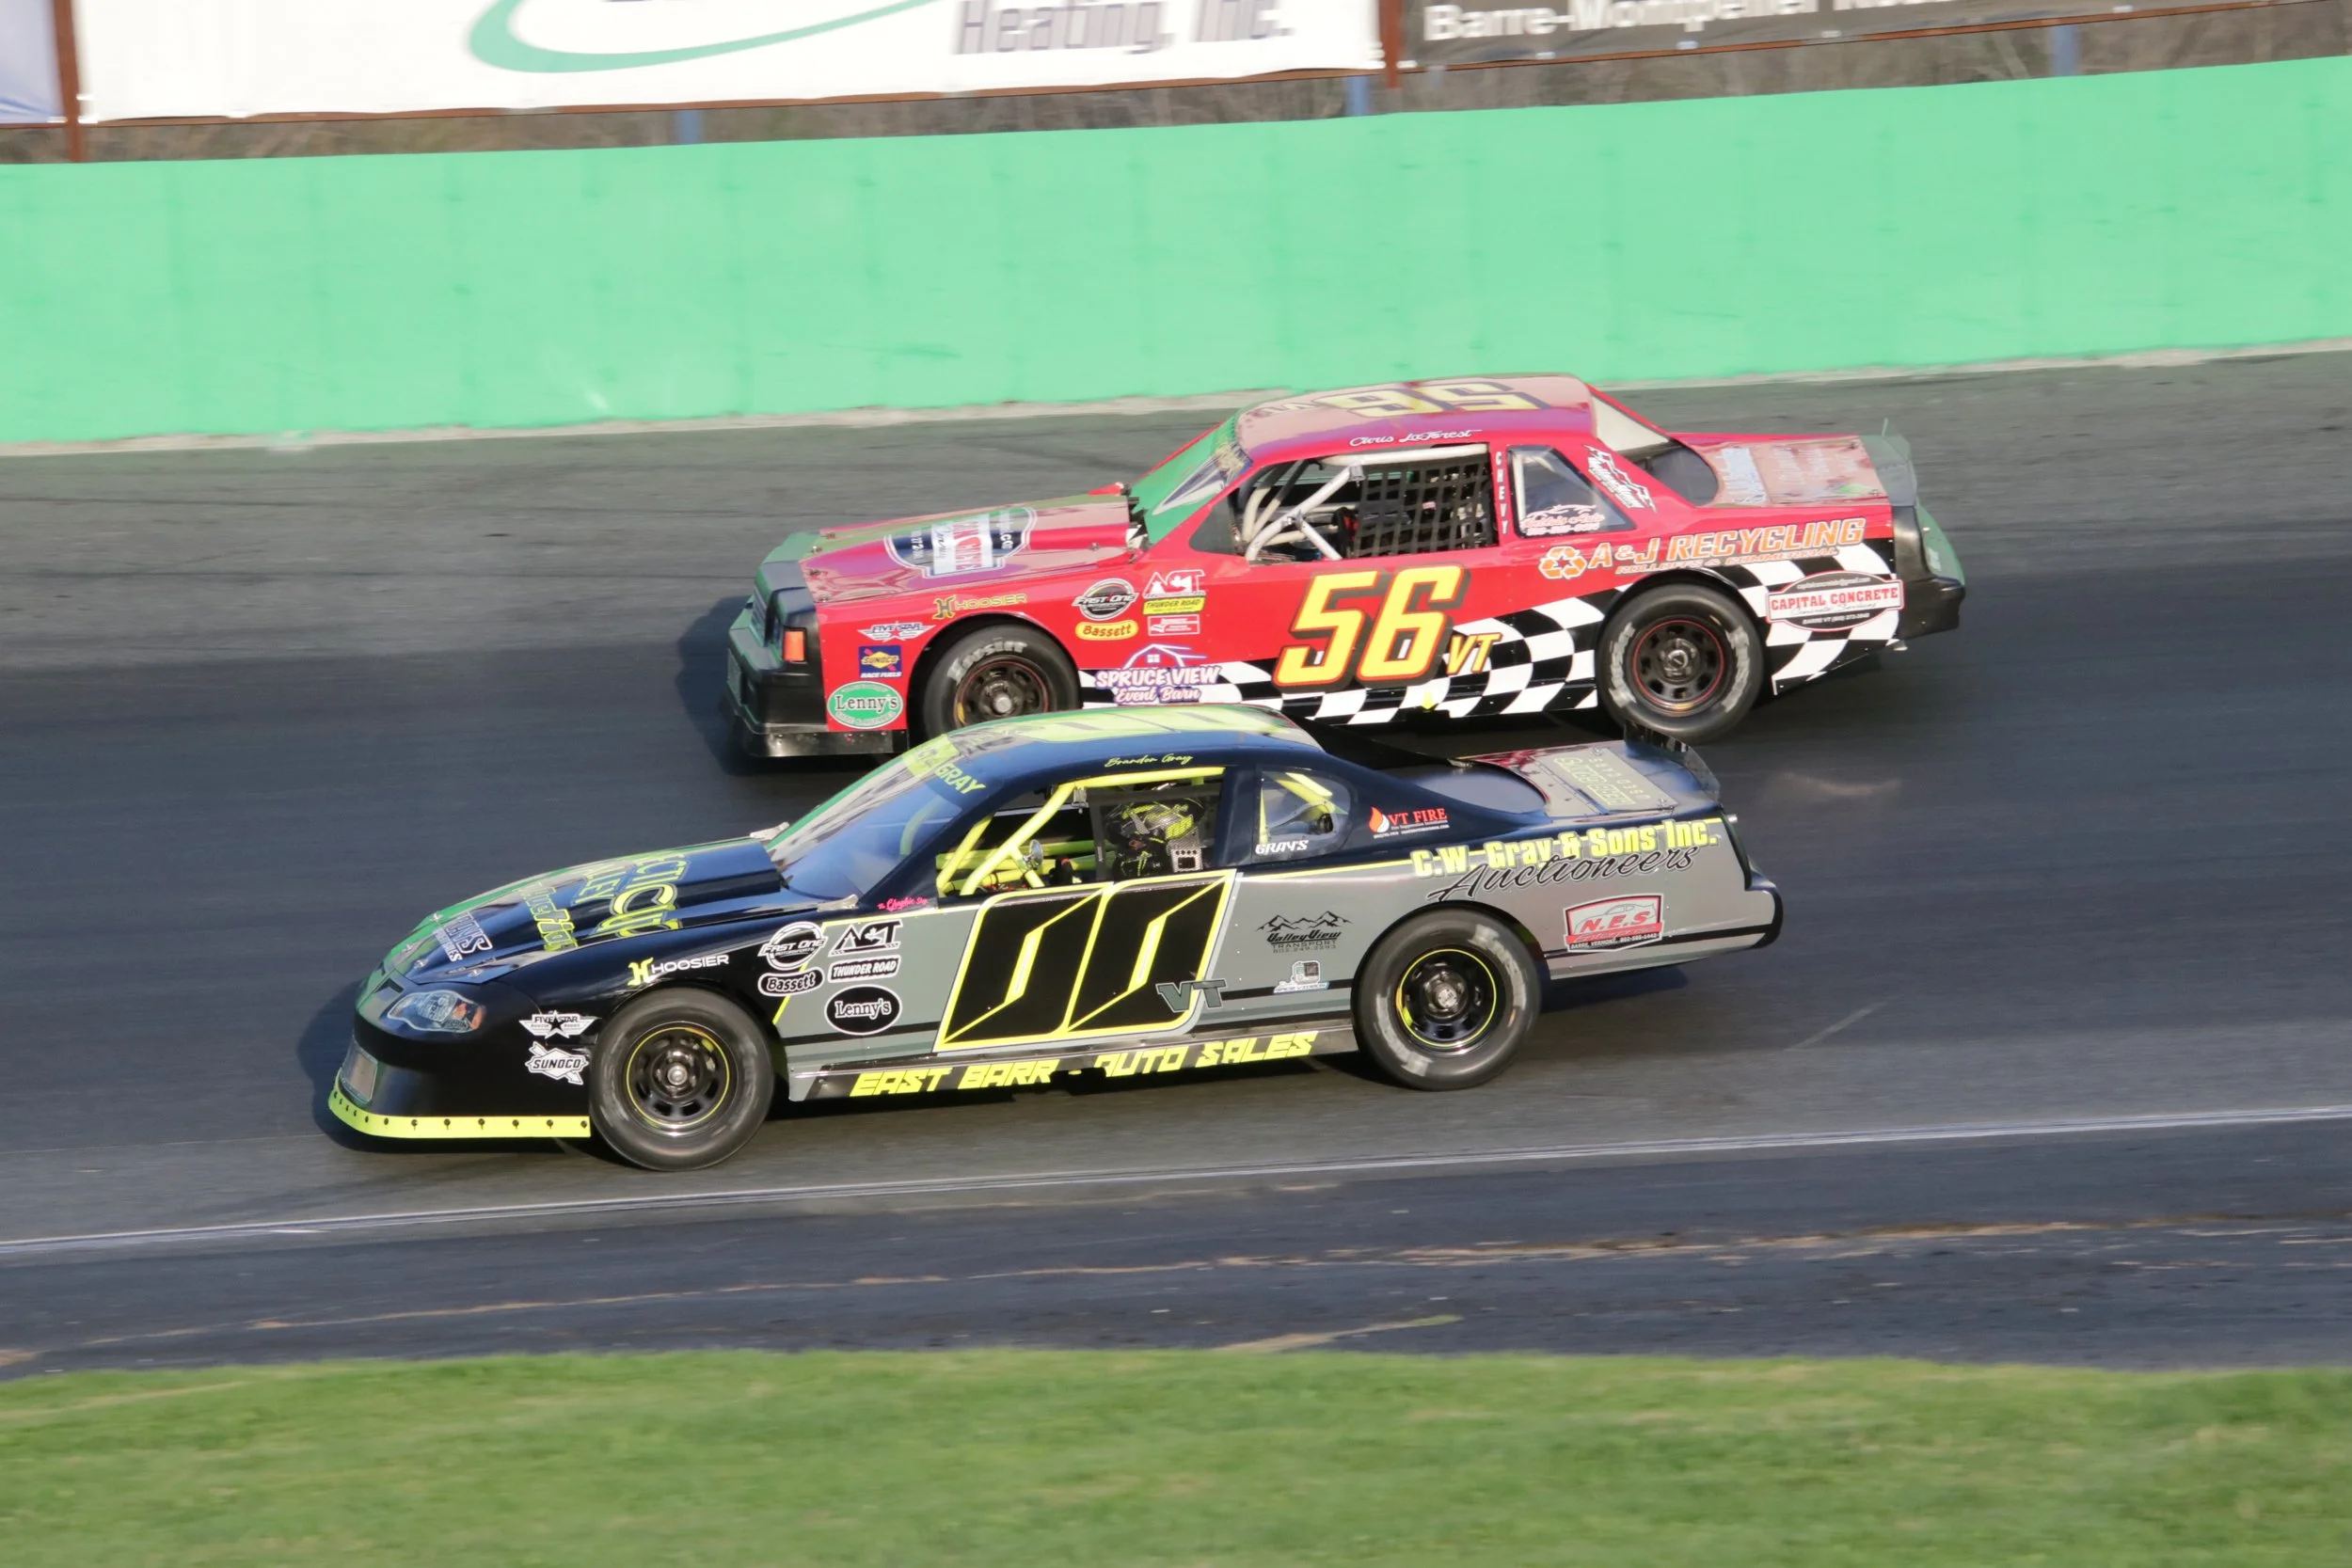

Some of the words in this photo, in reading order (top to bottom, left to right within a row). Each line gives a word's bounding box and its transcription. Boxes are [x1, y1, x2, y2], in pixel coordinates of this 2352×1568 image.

[1666, 517, 1867, 561] RECYCLING
[956, 594, 1027, 610] HOOSIER
[1771, 595, 1826, 610] CAPITAL
[1830, 588, 1899, 605] CONCRETE
[872, 625, 894, 633] FIVE
[898, 623, 921, 631] STAR
[1082, 624, 1132, 638] Bassett
[1273, 564, 1470, 690] 56
[863, 656, 898, 664] SUNOCO
[1446, 632, 1502, 675] VT
[1095, 668, 1168, 688] SPRUCE
[1169, 666, 1221, 685] VIEW
[834, 694, 898, 712] Lenny's
[1115, 687, 1158, 704] Event
[1159, 686, 1201, 702] Barn
[1104, 754, 1157, 768] Brandon
[1161, 753, 1194, 766] Gray
[934, 763, 986, 795] GRAY
[1388, 813, 1408, 826] VT
[1413, 808, 1447, 823] FIRE
[1255, 840, 1309, 855] GRAY'S
[1484, 836, 1552, 869] Gray
[1558, 832, 1582, 860] &
[1587, 826, 1656, 858] Sons
[1659, 820, 1717, 850] Inc.
[1424, 847, 1700, 902] Auctioneers
[763, 943, 797, 954] FAST
[799, 939, 824, 948] ONE
[829, 919, 902, 956] ACT
[651, 955, 729, 974] HOOSIER
[833, 963, 870, 977] THUNDER
[872, 960, 897, 974] ROAD
[767, 973, 816, 991] Bassett
[1154, 978, 1227, 1013] VT
[834, 998, 891, 1019] Lenny's
[532, 1058, 580, 1069] SUNOCO
[850, 1068, 953, 1098] EAST
[1094, 1046, 1185, 1078] AUTO
[1197, 1032, 1319, 1068] SALES
